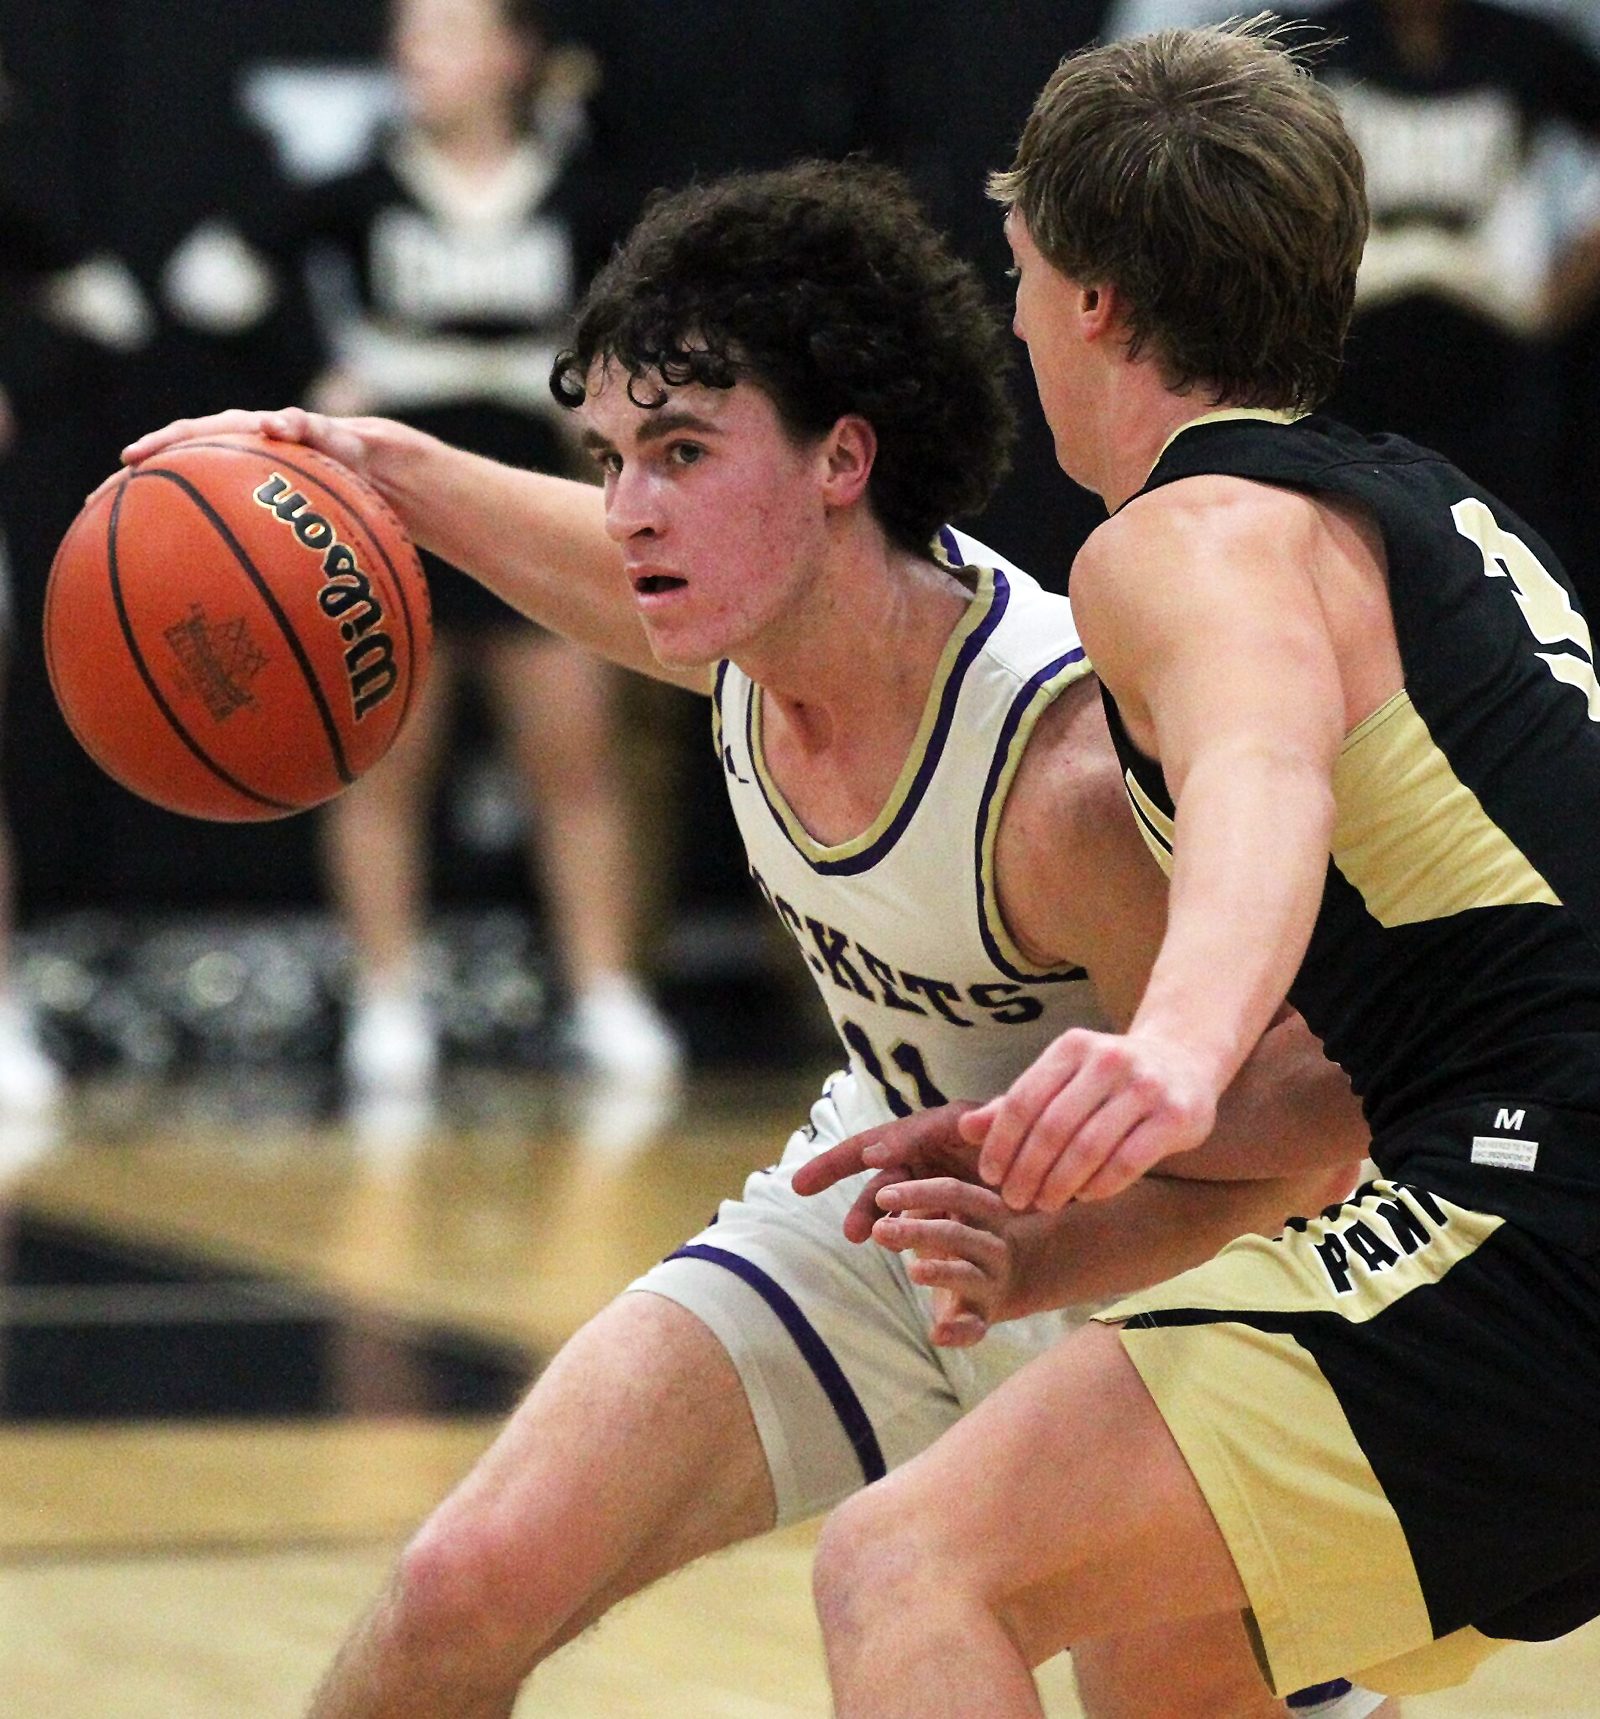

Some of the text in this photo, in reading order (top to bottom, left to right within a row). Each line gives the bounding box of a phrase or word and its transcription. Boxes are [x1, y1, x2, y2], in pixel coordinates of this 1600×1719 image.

[253, 472, 399, 721] Wilson
[842, 1018, 949, 1118] 11
[1493, 1108, 1526, 1131] M
